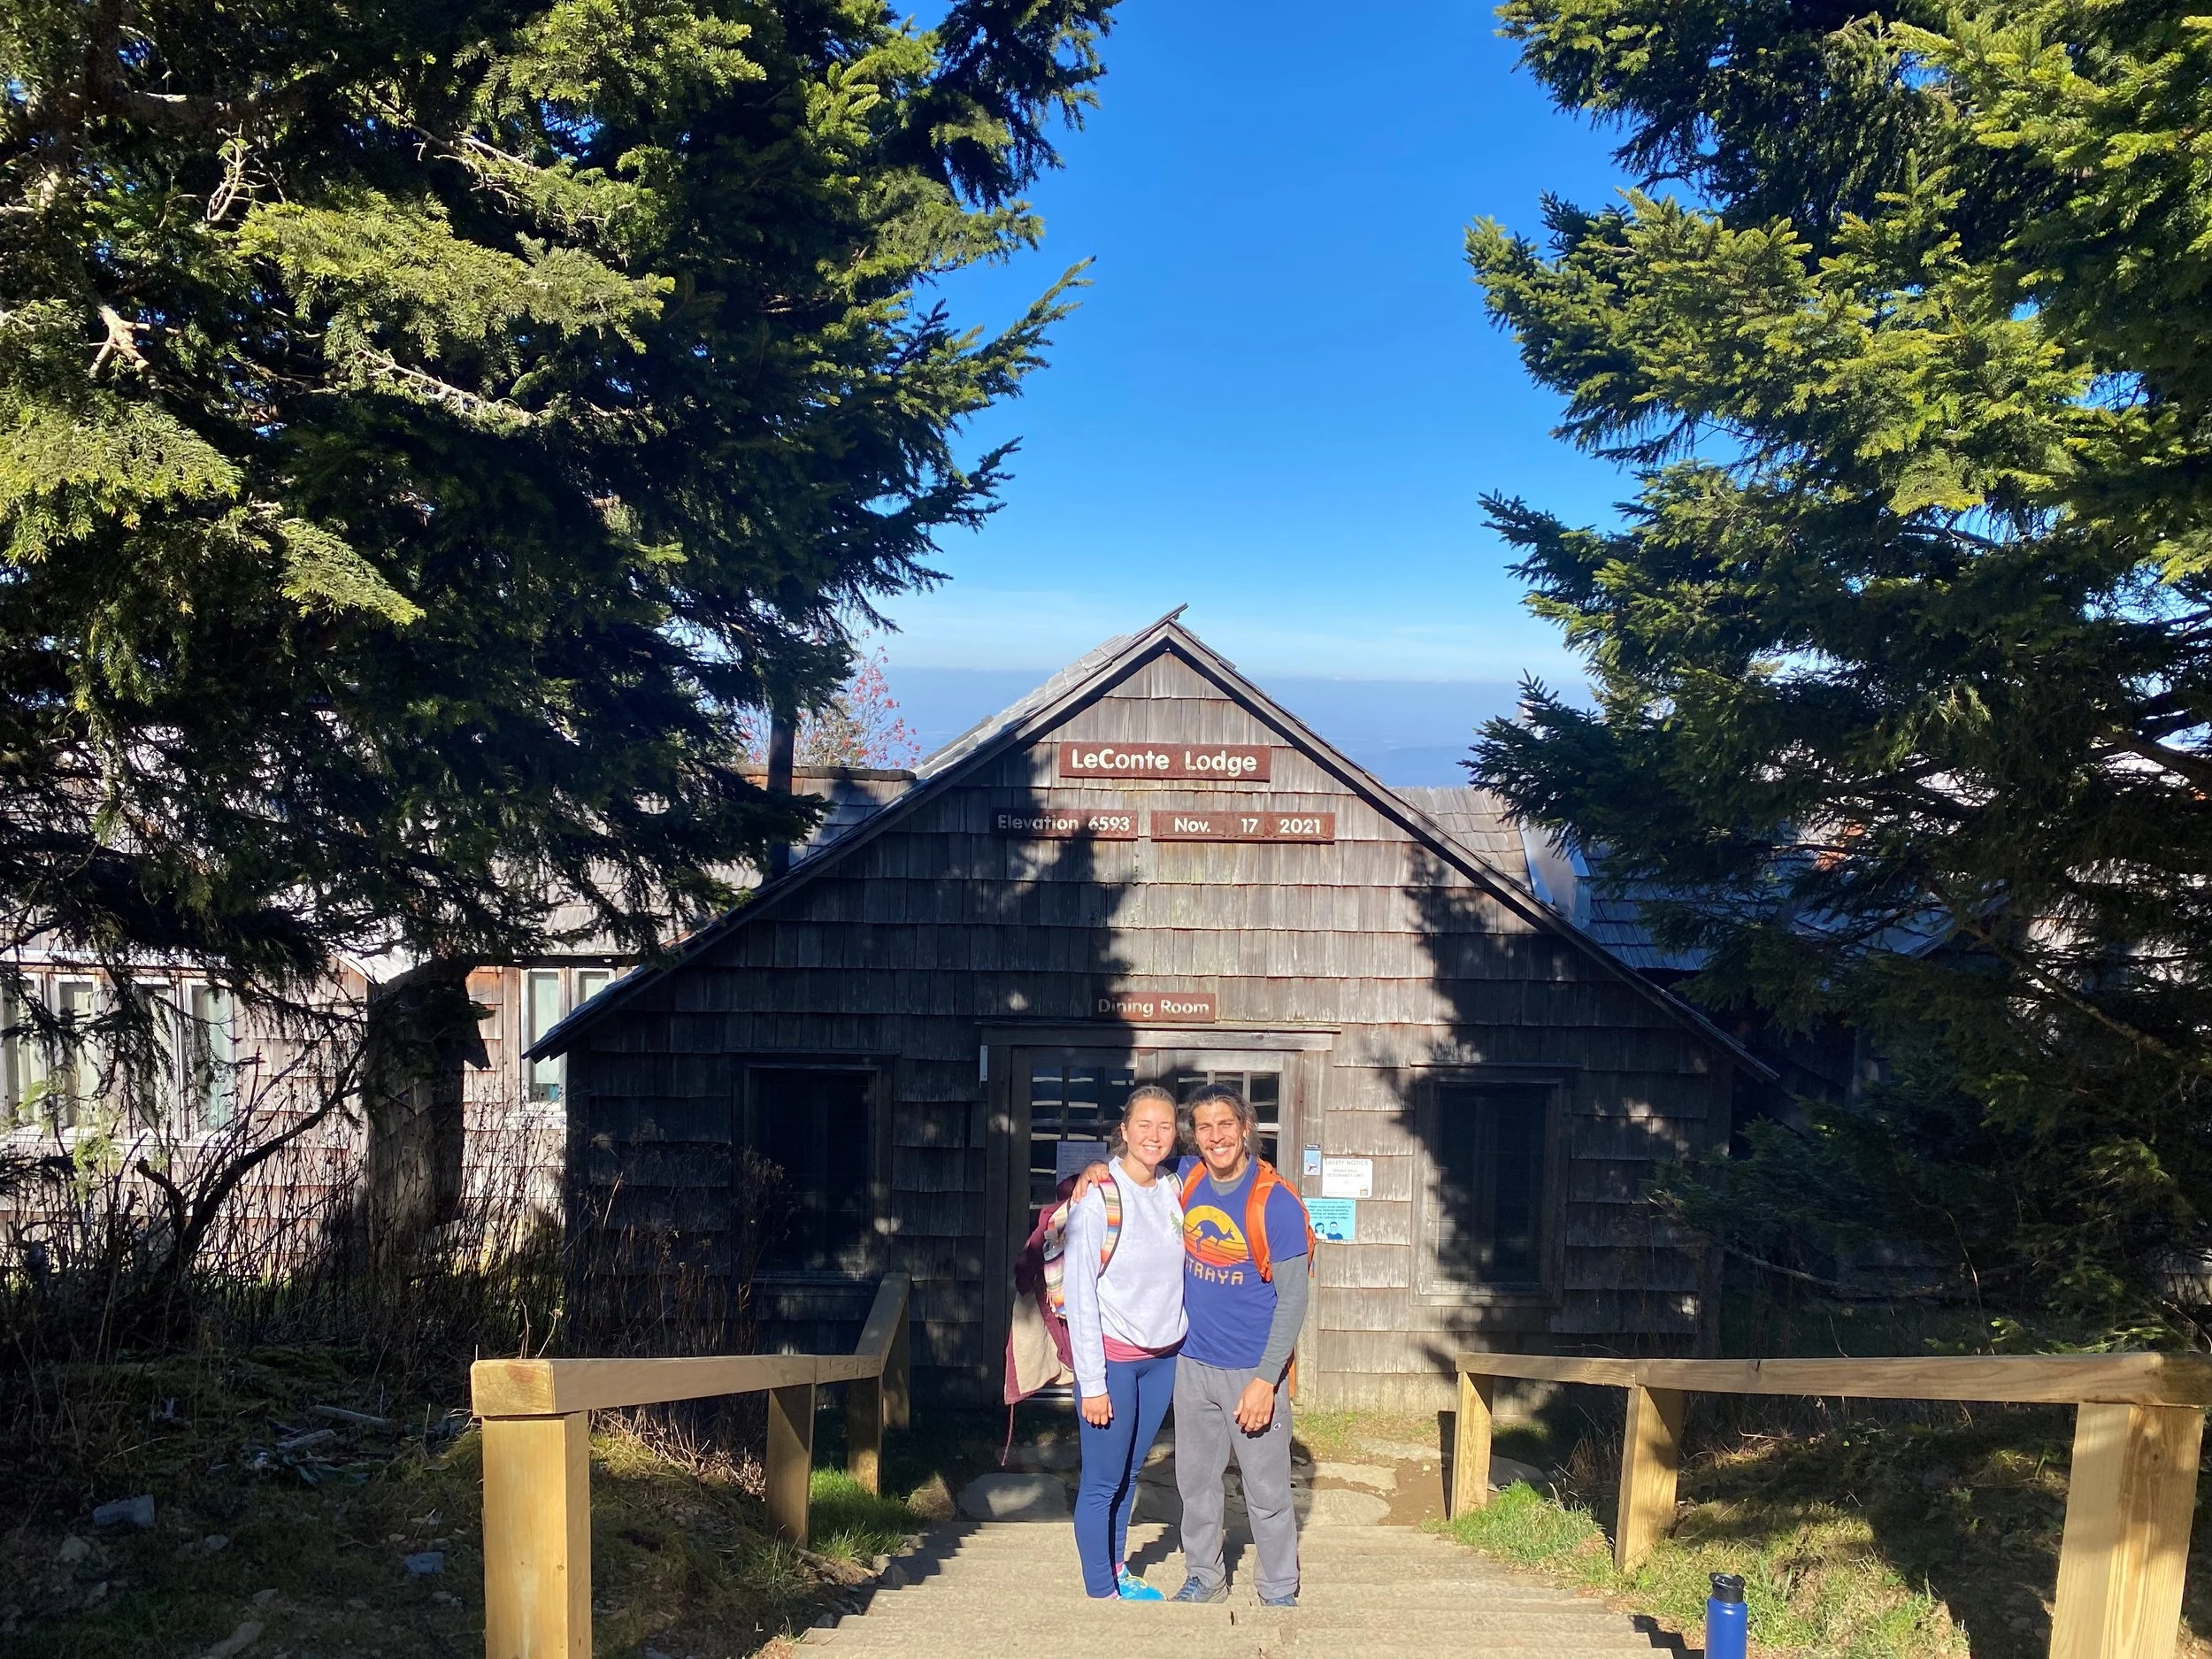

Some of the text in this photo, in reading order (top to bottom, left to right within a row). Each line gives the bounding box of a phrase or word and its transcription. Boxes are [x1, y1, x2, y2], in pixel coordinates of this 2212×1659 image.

[1071, 749, 1257, 777] LeConte Lodge
[997, 814, 1079, 830] Elevation
[1174, 817, 1320, 834] Nov. 17 2021
[1098, 997, 1210, 1018] Dining Room
